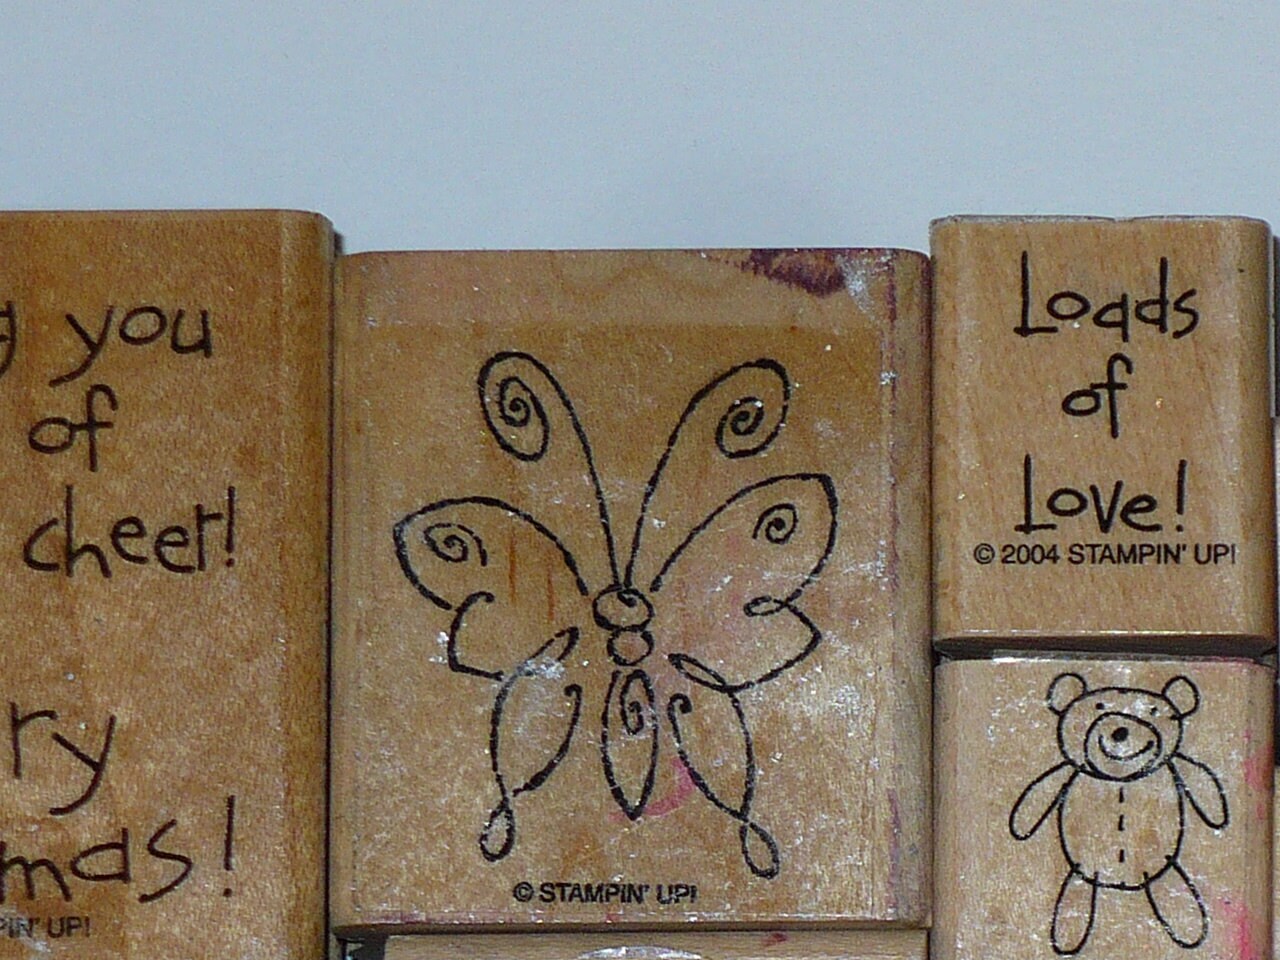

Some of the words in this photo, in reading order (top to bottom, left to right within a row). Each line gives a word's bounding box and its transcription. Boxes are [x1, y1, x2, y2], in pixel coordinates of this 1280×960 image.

[1013, 250, 1200, 342] Loads
[49, 305, 213, 387] you
[28, 383, 119, 473] of
[1061, 352, 1134, 439] of
[23, 484, 236, 579] cheer!
[1014, 453, 1187, 535] Love!
[1001, 544, 1060, 565] 2004
[1068, 543, 1187, 565] STAMPIN'
[1194, 544, 1237, 565] UP!
[47, 916, 90, 939] UP!
[539, 882, 650, 904] STAMPIN'
[656, 884, 698, 904] UP!
